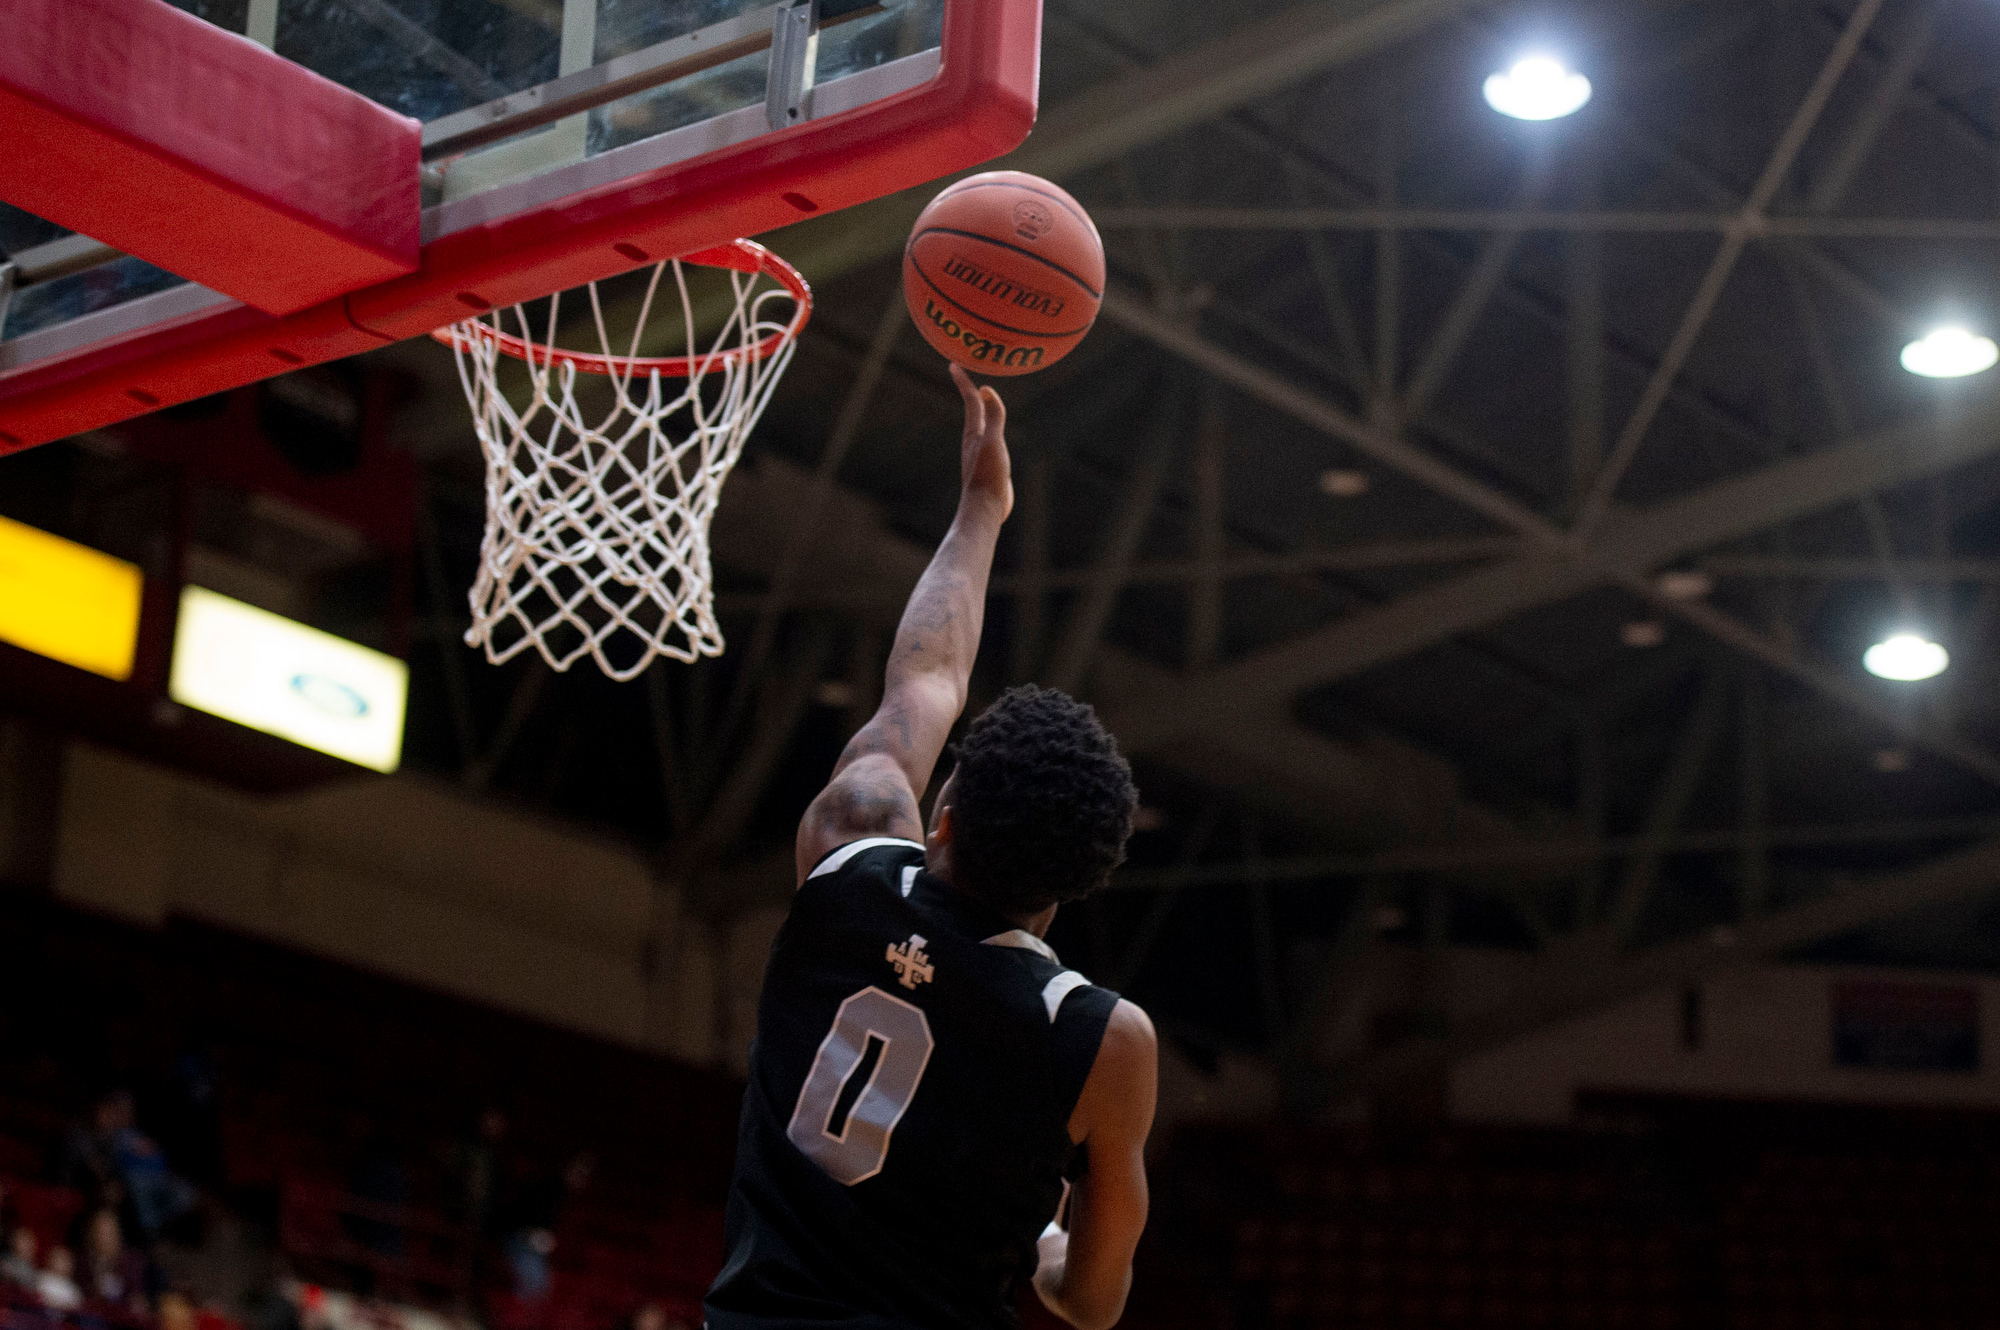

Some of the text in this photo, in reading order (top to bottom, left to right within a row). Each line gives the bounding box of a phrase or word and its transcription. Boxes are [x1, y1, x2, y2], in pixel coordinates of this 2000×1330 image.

[943, 257, 1065, 317] EVOLUTION
[925, 299, 1044, 366] Wilson
[786, 985, 936, 1187] 0
